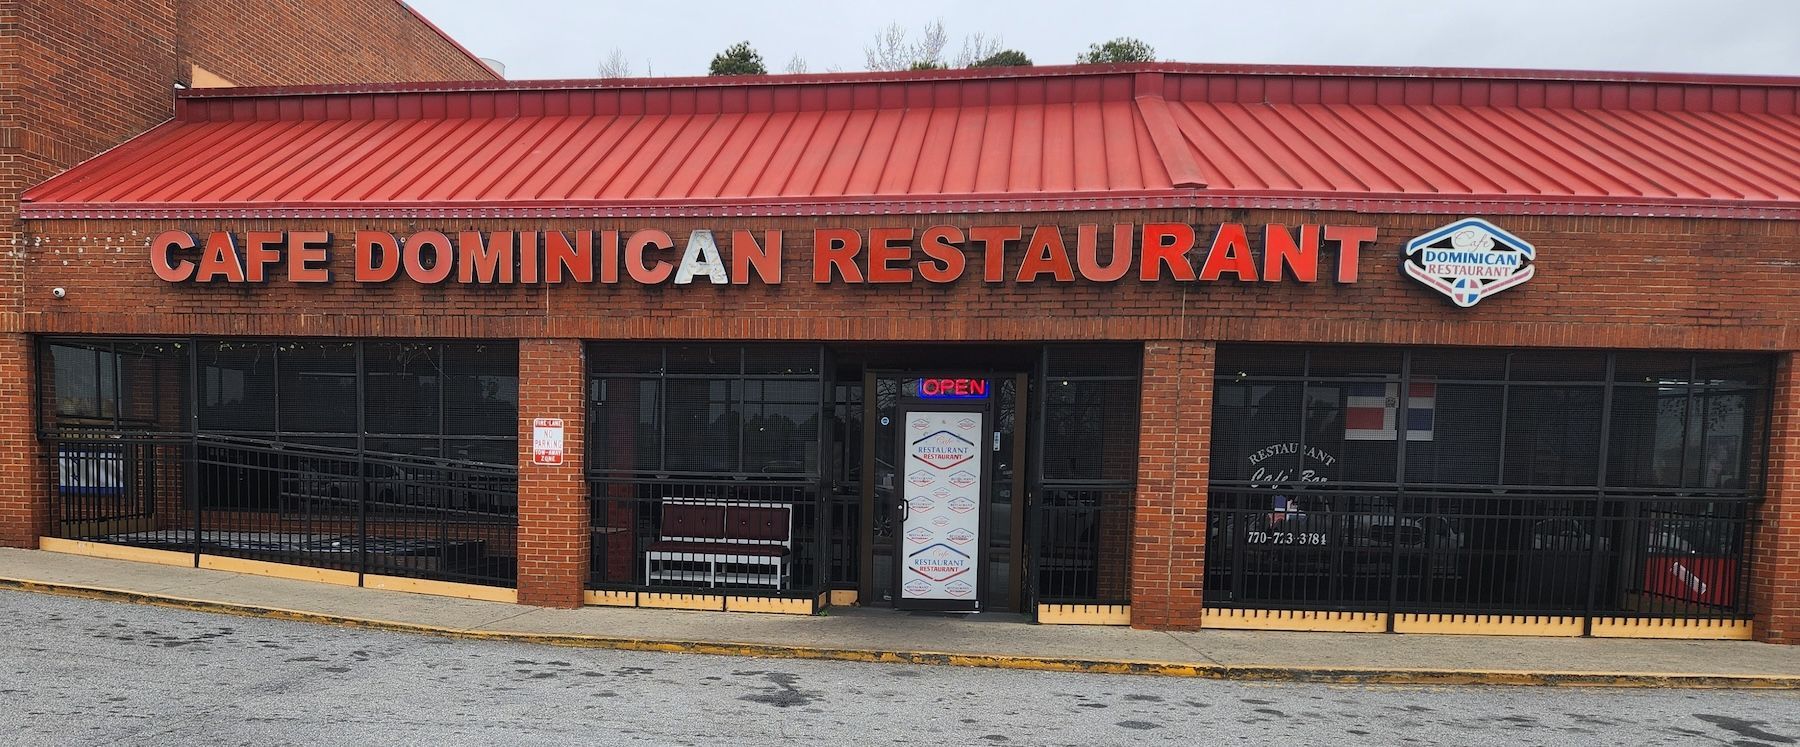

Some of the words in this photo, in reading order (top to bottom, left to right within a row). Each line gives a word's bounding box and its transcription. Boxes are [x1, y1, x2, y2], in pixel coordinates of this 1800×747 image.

[1453, 230, 1490, 251] Cafe
[150, 230, 331, 283] CAFE
[355, 229, 783, 285] DOMINICAN
[813, 223, 1378, 285] RESTAURANT
[1425, 251, 1517, 266] DOMINICAN
[1428, 264, 1511, 277] RESTAURANT
[922, 378, 985, 395] OPEN
[544, 429, 553, 439] NO
[535, 440, 562, 449] PARKING
[918, 446, 968, 454] RESTAURANT
